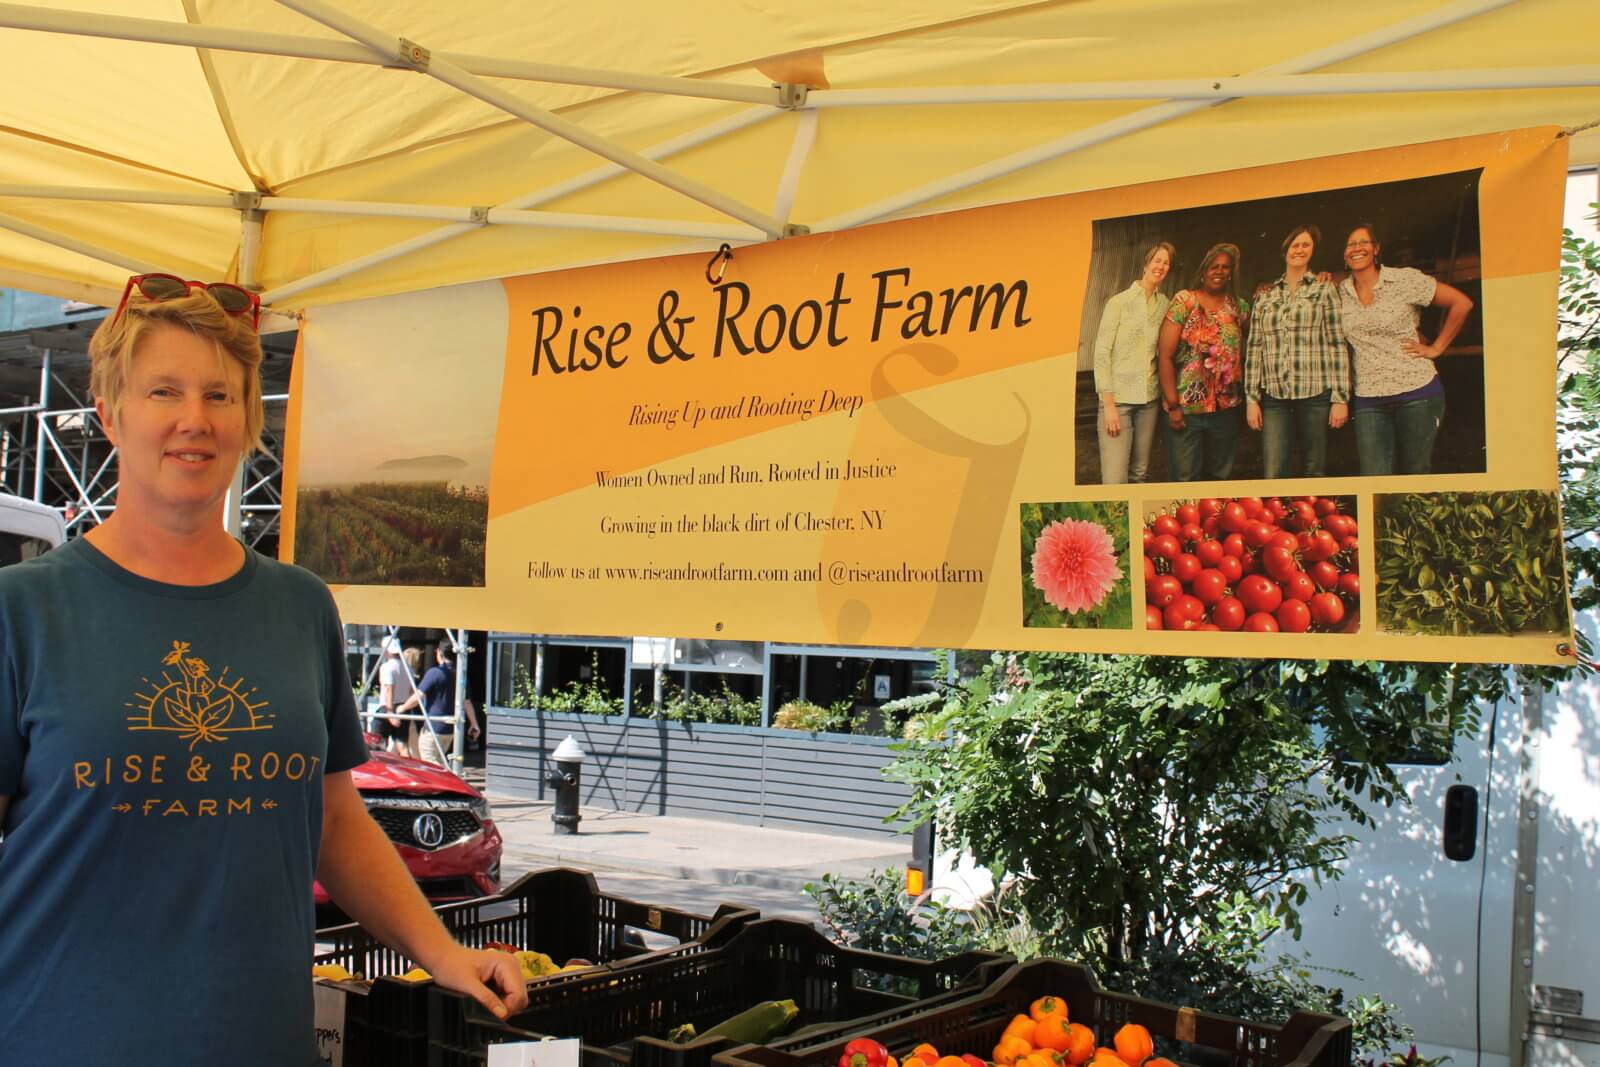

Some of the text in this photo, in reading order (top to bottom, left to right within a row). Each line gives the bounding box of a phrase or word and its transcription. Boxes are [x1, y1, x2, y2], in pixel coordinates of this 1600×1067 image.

[531, 267, 1032, 377] Rise & Root Farm
[628, 389, 864, 430] Rising Up and Rooting Deep
[595, 470, 643, 489] Women
[647, 466, 695, 486] Owned
[698, 465, 725, 484] and
[768, 461, 820, 482] Rooted
[825, 460, 839, 480] in
[843, 458, 897, 481] Justice
[600, 515, 656, 539] Growing
[660, 514, 672, 533] in
[677, 513, 698, 533] the
[702, 513, 740, 533] black
[744, 512, 770, 532] dirt
[775, 512, 791, 532] of
[860, 509, 886, 530] NY
[527, 560, 984, 586] Follow us at www.riseandrootfarm.com and @riseandrootfarm
[74, 752, 320, 790] RISE & ROOT
[142, 797, 251, 817] FARM
